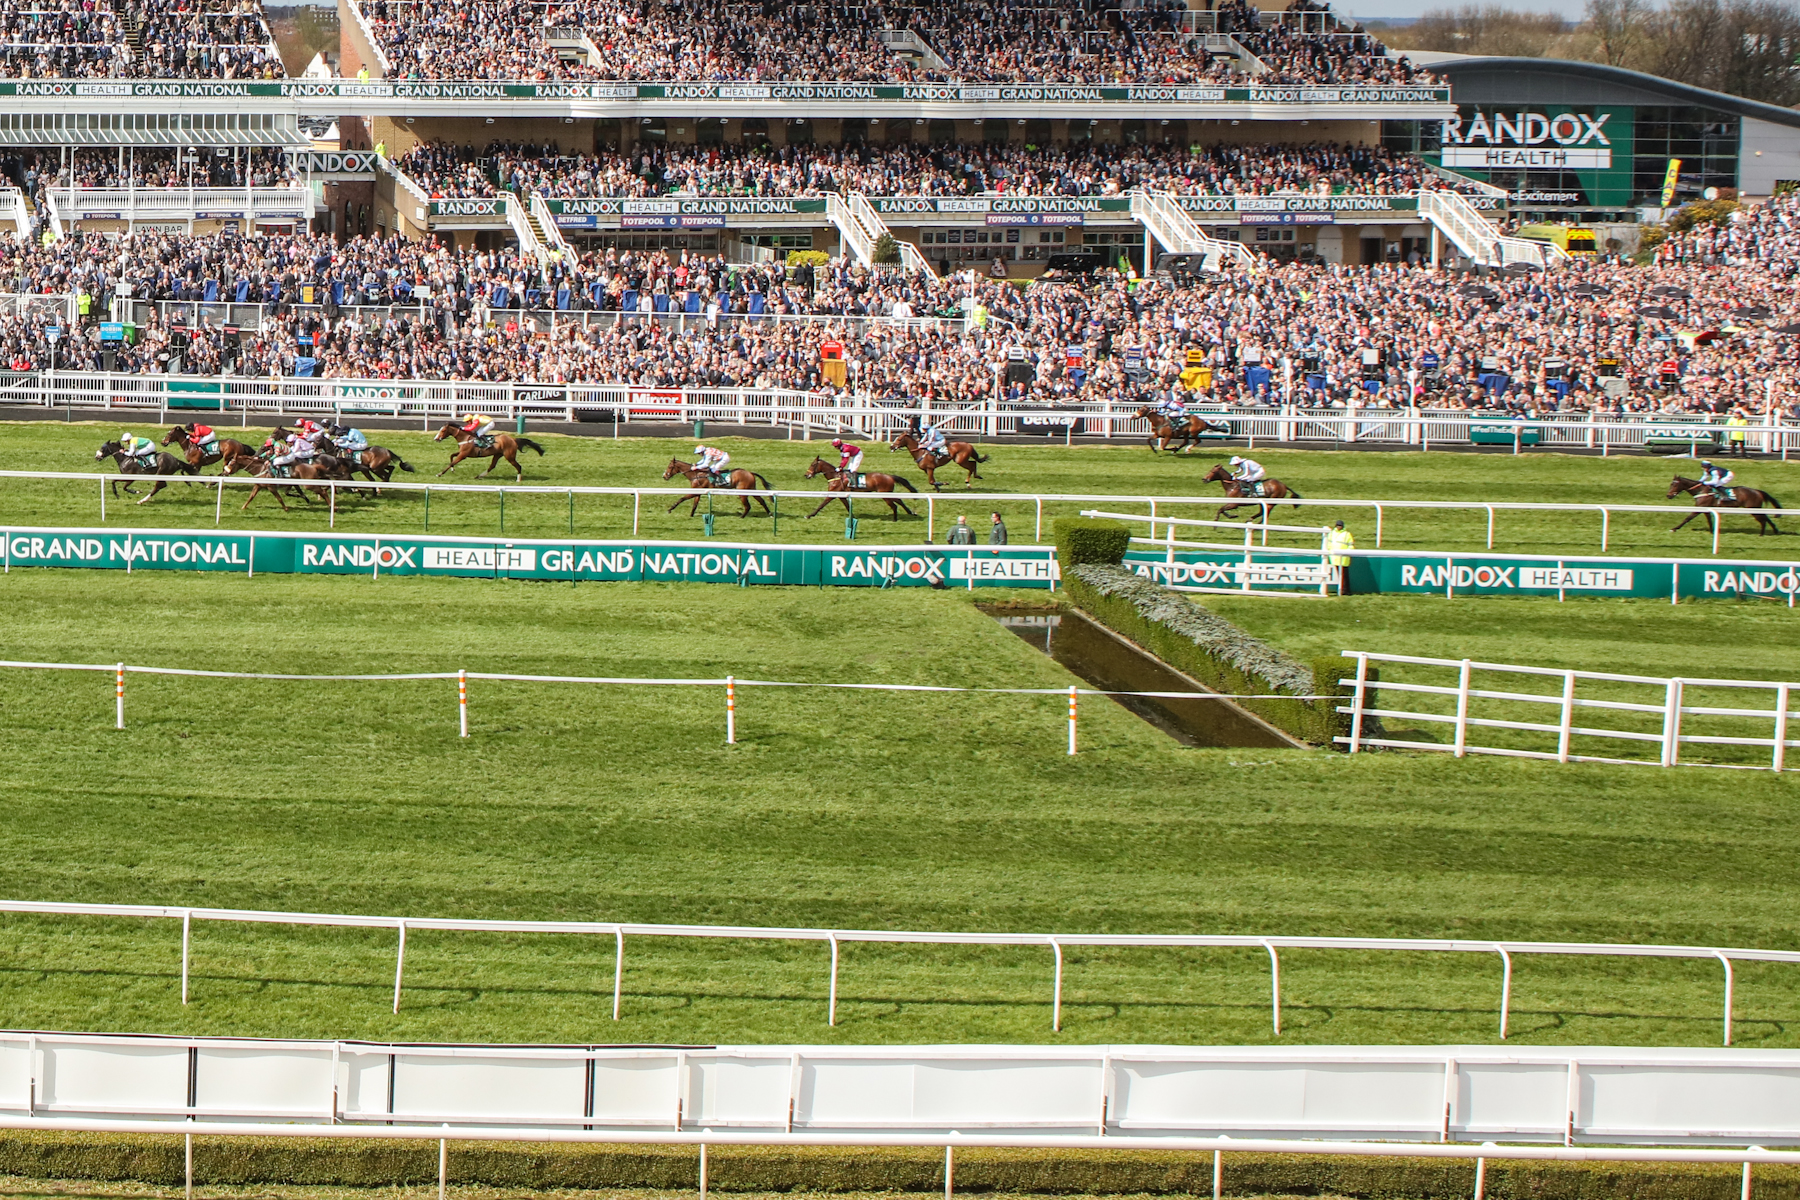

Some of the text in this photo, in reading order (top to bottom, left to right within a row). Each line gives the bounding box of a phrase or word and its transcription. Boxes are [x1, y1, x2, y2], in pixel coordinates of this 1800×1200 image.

[15, 83, 251, 97] RANDOX HEALTH GRAND NATIONAL
[280, 84, 507, 97] RANDOX HEALTH GRAND NATIONAL
[535, 86, 633, 97] RANDOX HEALTH
[664, 86, 878, 99] RANDOX HEALTH GRAND NATIONAL
[903, 87, 1103, 100] RANDOX HEALTH GRAND NATIONAL
[1128, 88, 1220, 100] RANDOX HEALTH
[1249, 90, 1300, 102] RANDOX
[1341, 90, 1381, 102] GRAND
[1382, 90, 1438, 102] NATIONAL
[1441, 112, 1611, 146] RANDOX
[1485, 150, 1567, 167] HEALTH
[438, 202, 496, 214] RANDOX
[563, 201, 797, 214] RANDOX HEALTH GRAND NATIONAL
[880, 200, 1102, 213] RANDOX HEALTH GRAND NATIONAL
[1180, 199, 1391, 211] RANDOX HEALTH GRAND NATIONAL
[557, 215, 588, 224] BETFRED
[623, 216, 723, 225] TOTEPOOL TOTEPOOL
[986, 215, 1082, 224] TOTEPOOL TOTEPOOL
[1241, 214, 1333, 223] TOTEPOOL TOTEPOOL
[135, 225, 183, 233] LAWN BAR
[517, 389, 562, 401] CARLING
[632, 392, 679, 404] Mirror
[10, 536, 103, 561] GRAND
[110, 538, 246, 564] NATIONAL
[302, 544, 777, 577] RANDOX HEALTH GRAND NATIONAL
[831, 555, 1049, 579] RANDOX HEALTH
[1135, 561, 1231, 584] ANDOX
[1401, 565, 1618, 588] RANDOX HEALTH
[1703, 570, 1800, 594] RANDO
